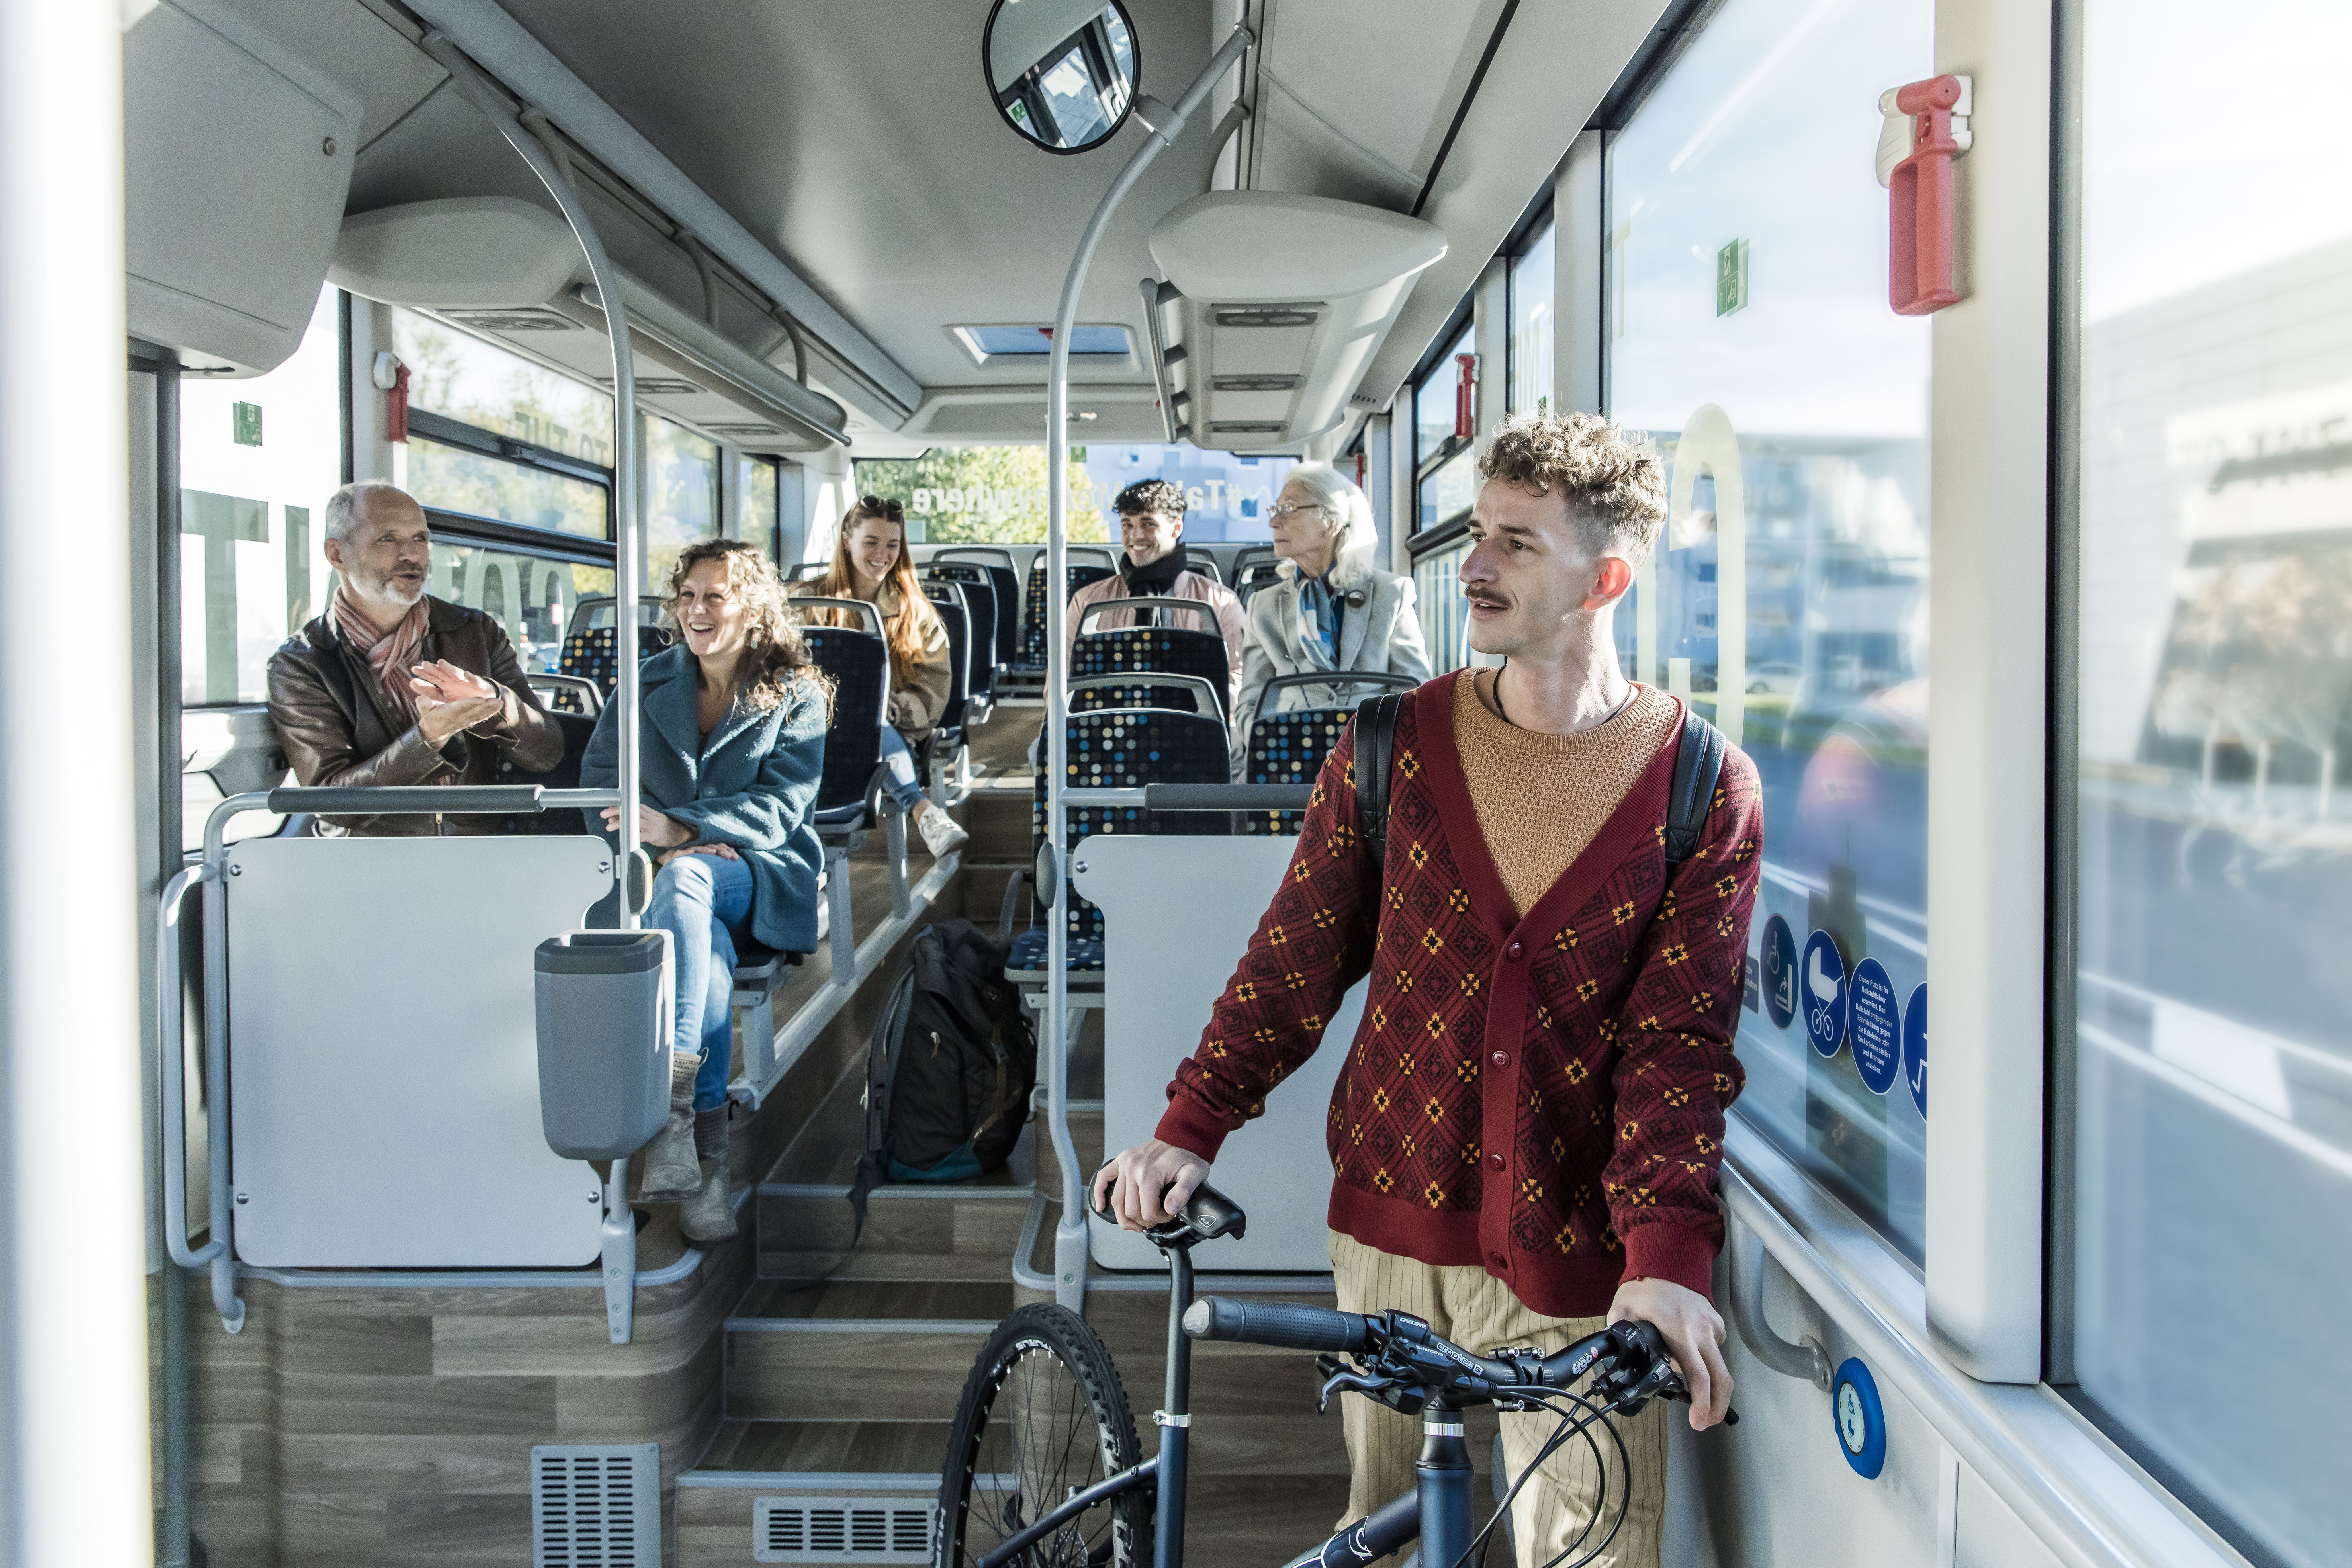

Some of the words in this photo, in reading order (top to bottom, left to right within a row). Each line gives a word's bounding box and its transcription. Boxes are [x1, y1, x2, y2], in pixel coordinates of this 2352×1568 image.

[1859, 974, 1870, 985] Dieser
[1861, 985, 1886, 1003] Rollstuhlfahrer
[1862, 997, 1878, 1010] reserviert.
[1856, 1003, 1870, 1016] Rollstuhl
[1871, 1013, 1886, 1025] entgegen
[1857, 1014, 1879, 1033] Fahrtrichtung
[1880, 1028, 1890, 1039] gegen
[1864, 1028, 1881, 1043] Haltelehne
[1857, 1034, 1878, 1052] Rückenlehne
[1879, 1048, 1890, 1059] stellen
[1870, 1052, 1884, 1066] Bremsen
[1866, 1061, 1881, 1075] anziehen.
[1400, 1317, 1427, 1329] DEORE
[1416, 1345, 1444, 1357] SHIMANO
[1437, 1343, 1474, 1369] ergotec
[1572, 1354, 1593, 1374] Ergo
